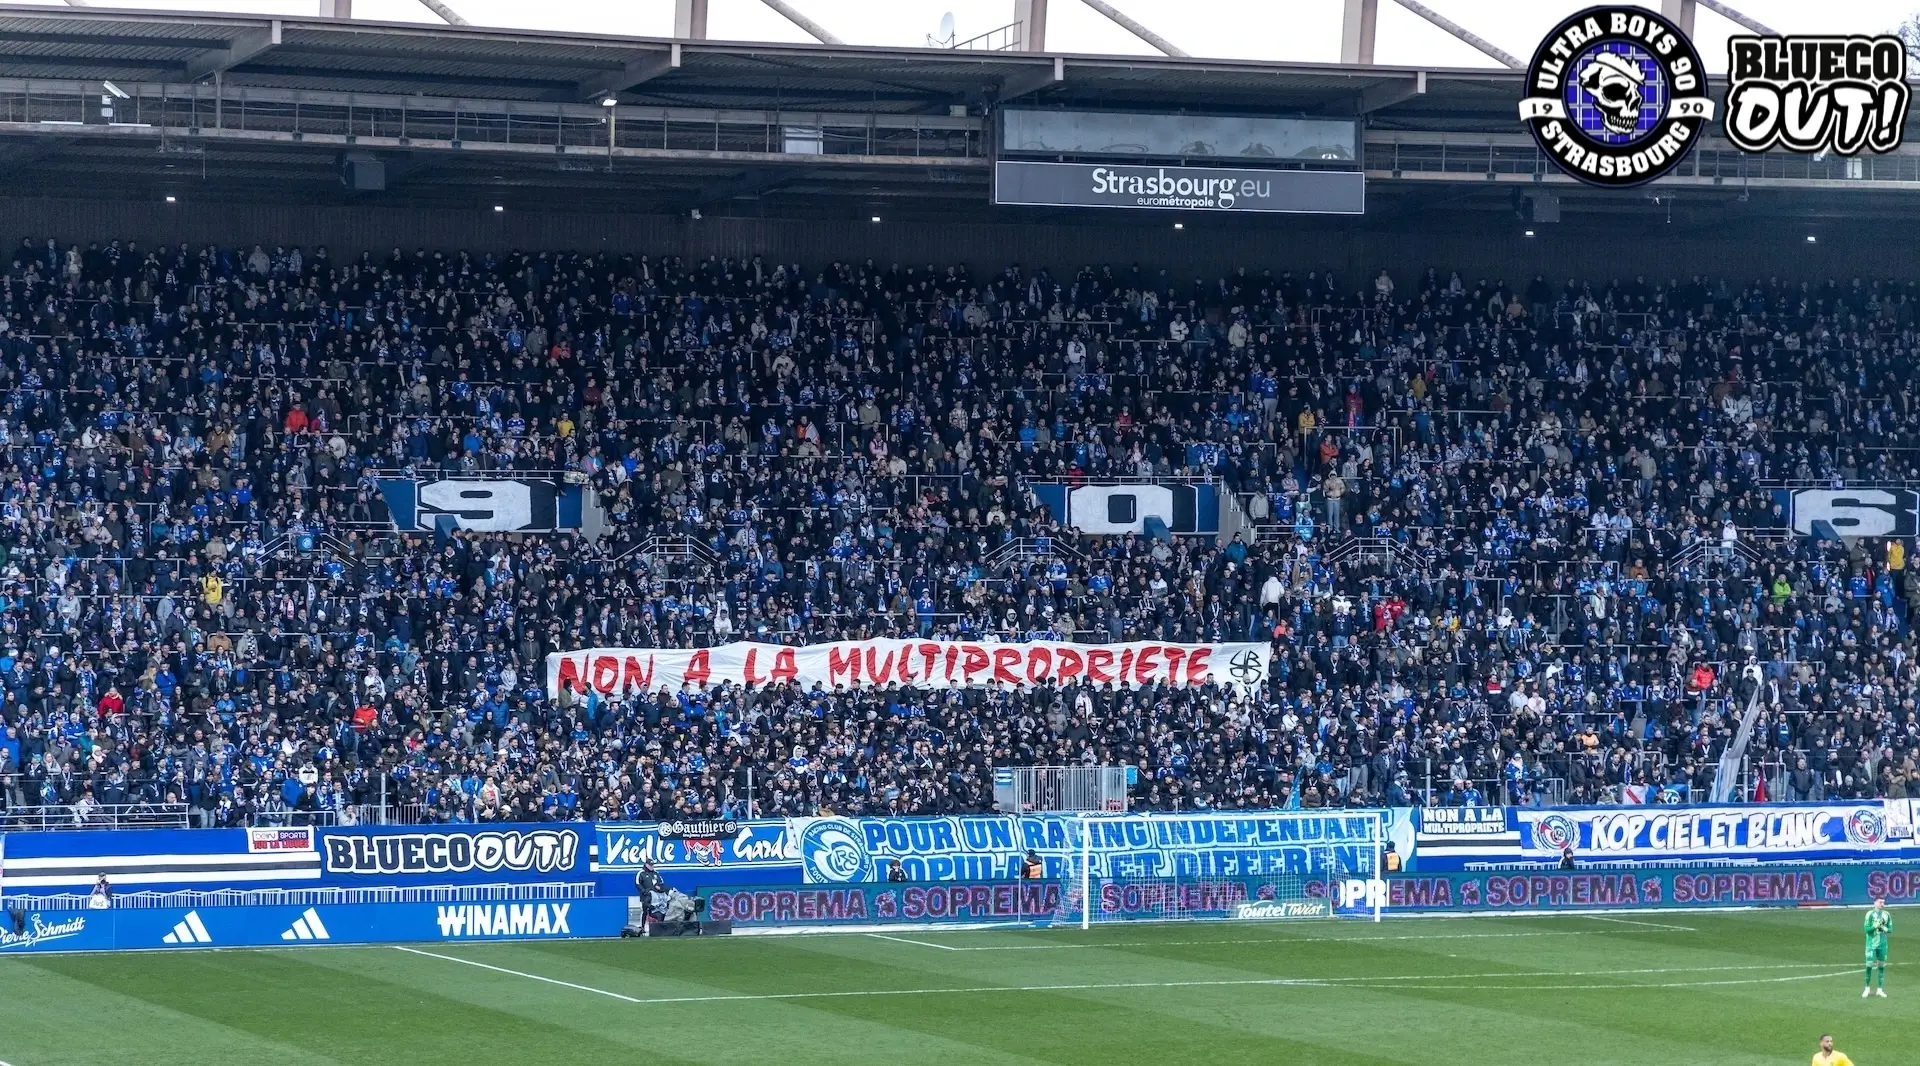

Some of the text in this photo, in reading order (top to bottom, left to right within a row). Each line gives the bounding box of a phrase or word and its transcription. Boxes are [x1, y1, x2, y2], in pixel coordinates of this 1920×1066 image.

[1092, 168, 1271, 209] Strasbourg.eu
[1137, 196, 1214, 209] eurométropole
[556, 653, 653, 695] NON
[683, 649, 711, 693] A
[743, 647, 799, 687] LA
[829, 645, 1214, 688] MULTIPROPRIETE
[672, 820, 724, 835] Gauthier
[1423, 808, 1504, 822] NON A LA
[1423, 822, 1505, 834] MULTIPROPRIETE
[1590, 813, 1647, 851] KOP
[1649, 813, 1705, 851] CIEL
[1709, 812, 1743, 850] ET
[1746, 811, 1831, 849] BLANC
[279, 831, 307, 840] SPORTS
[862, 819, 958, 852] POUR
[961, 818, 1014, 850] UN
[1022, 819, 1152, 850] RACING
[326, 831, 578, 872] BLUECO OUT!
[902, 884, 1062, 918] SOPREMA
[1486, 874, 1640, 906] SOPREMA
[1673, 871, 1817, 903] SOPREMA
[437, 902, 571, 937] WINAMAX
[710, 888, 868, 921] SOPREMA
[1237, 902, 1326, 919] Tourtel Twist
[26, 916, 87, 947] Schmidt
